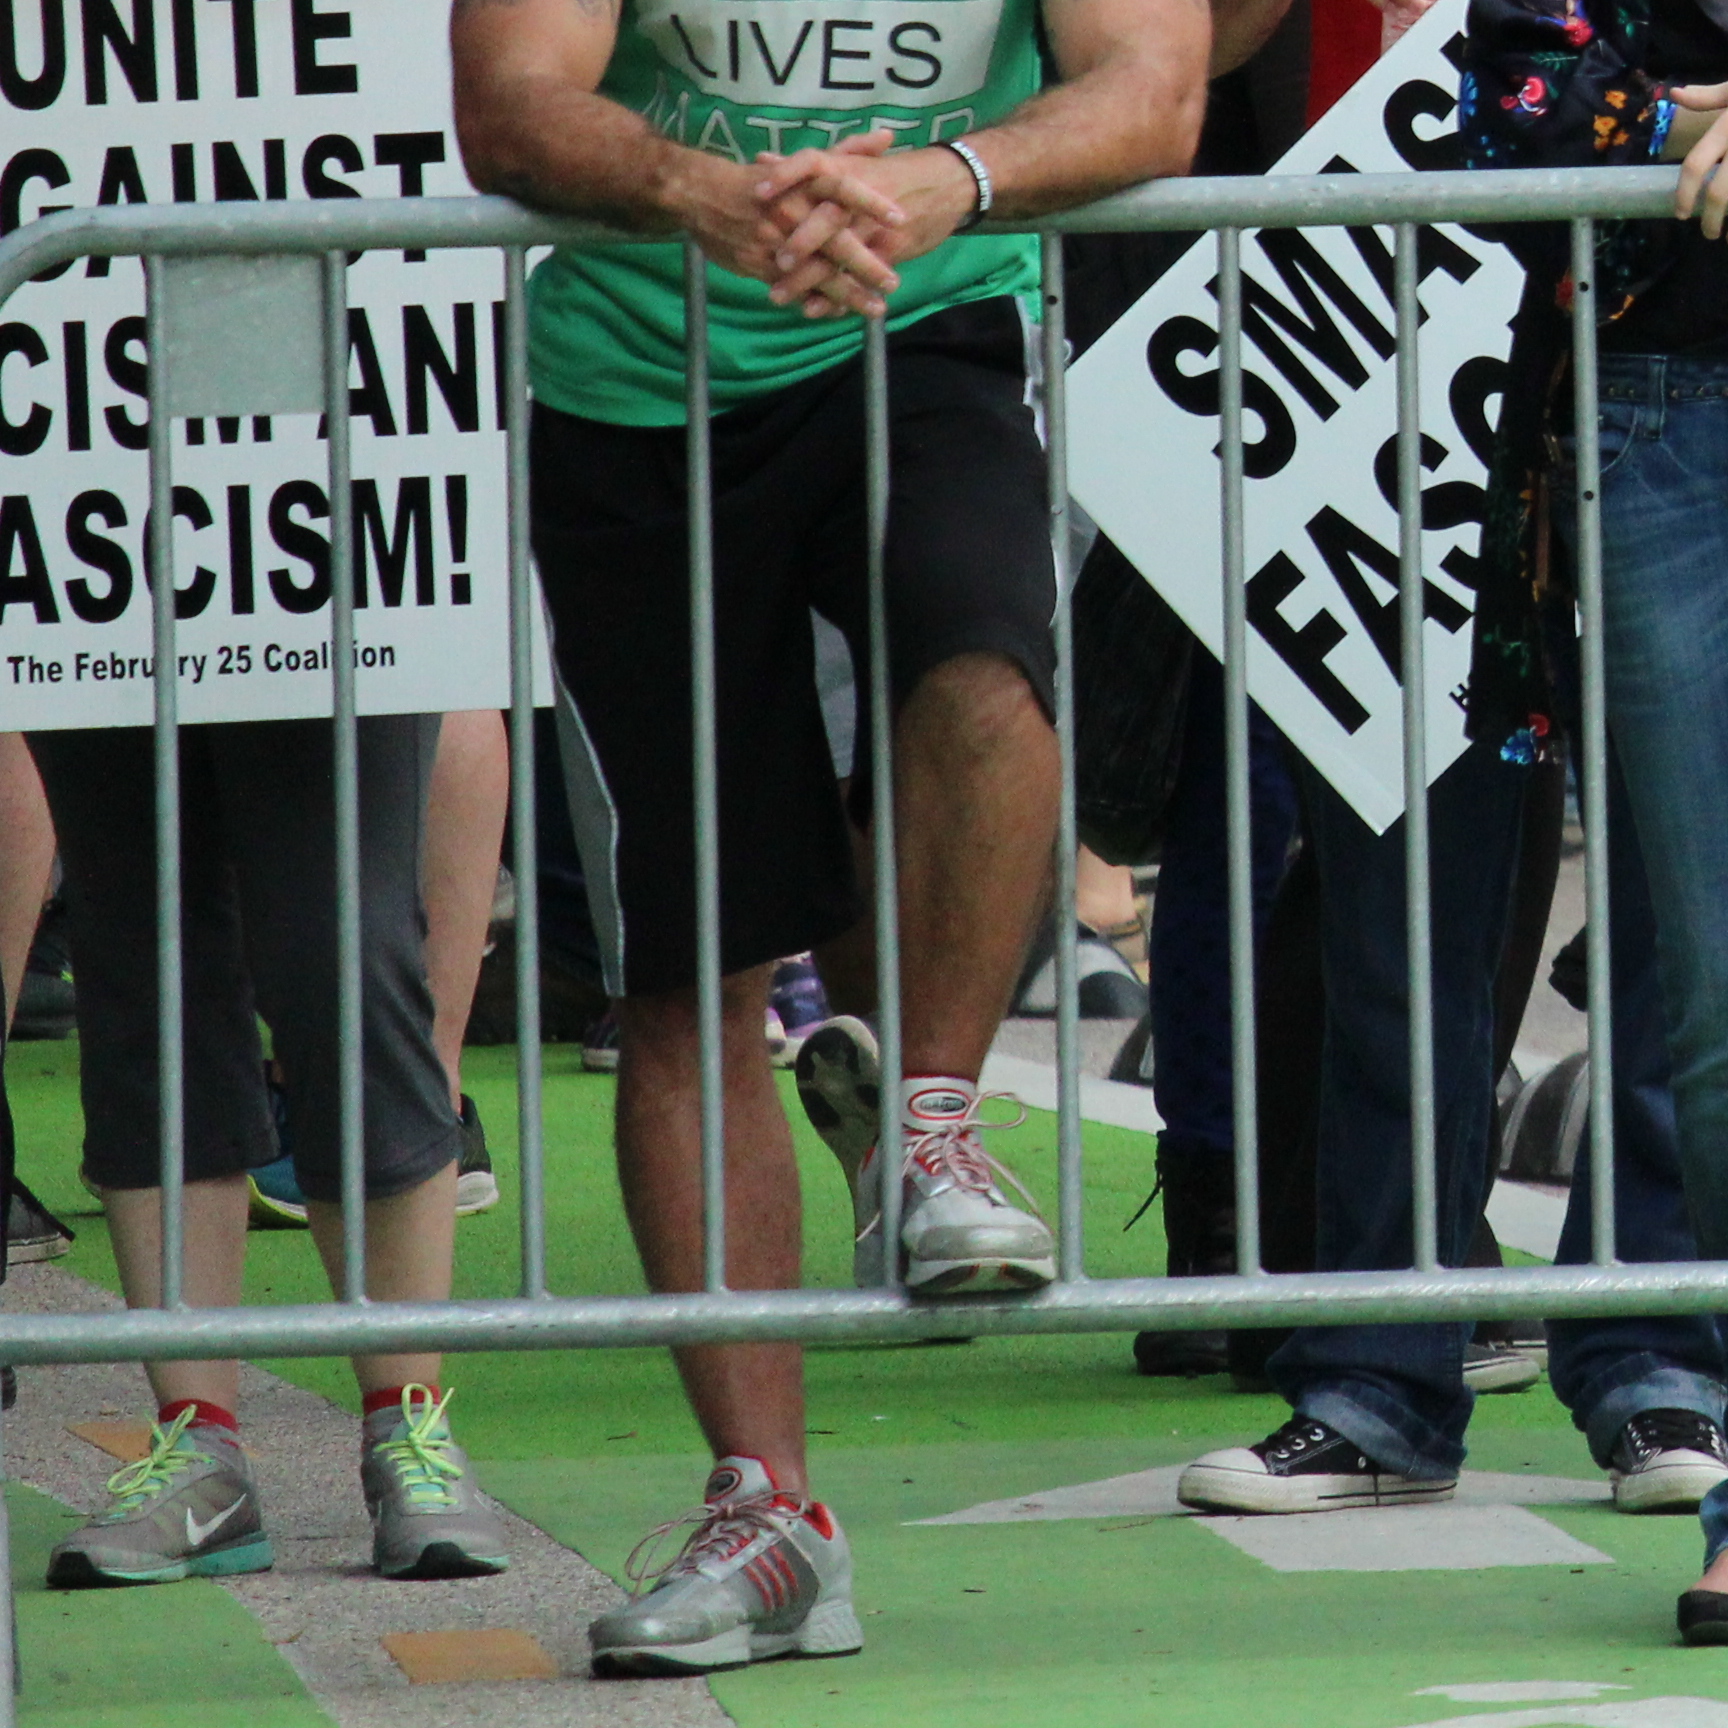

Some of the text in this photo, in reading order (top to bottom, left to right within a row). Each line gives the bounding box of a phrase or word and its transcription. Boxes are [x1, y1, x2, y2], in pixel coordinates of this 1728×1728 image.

[669, 12, 944, 91] LIVES
[1145, 30, 1504, 480] SMA
[0, 315, 273, 456] CIS
[8, 639, 396, 685] The Februry 25 Coalion
